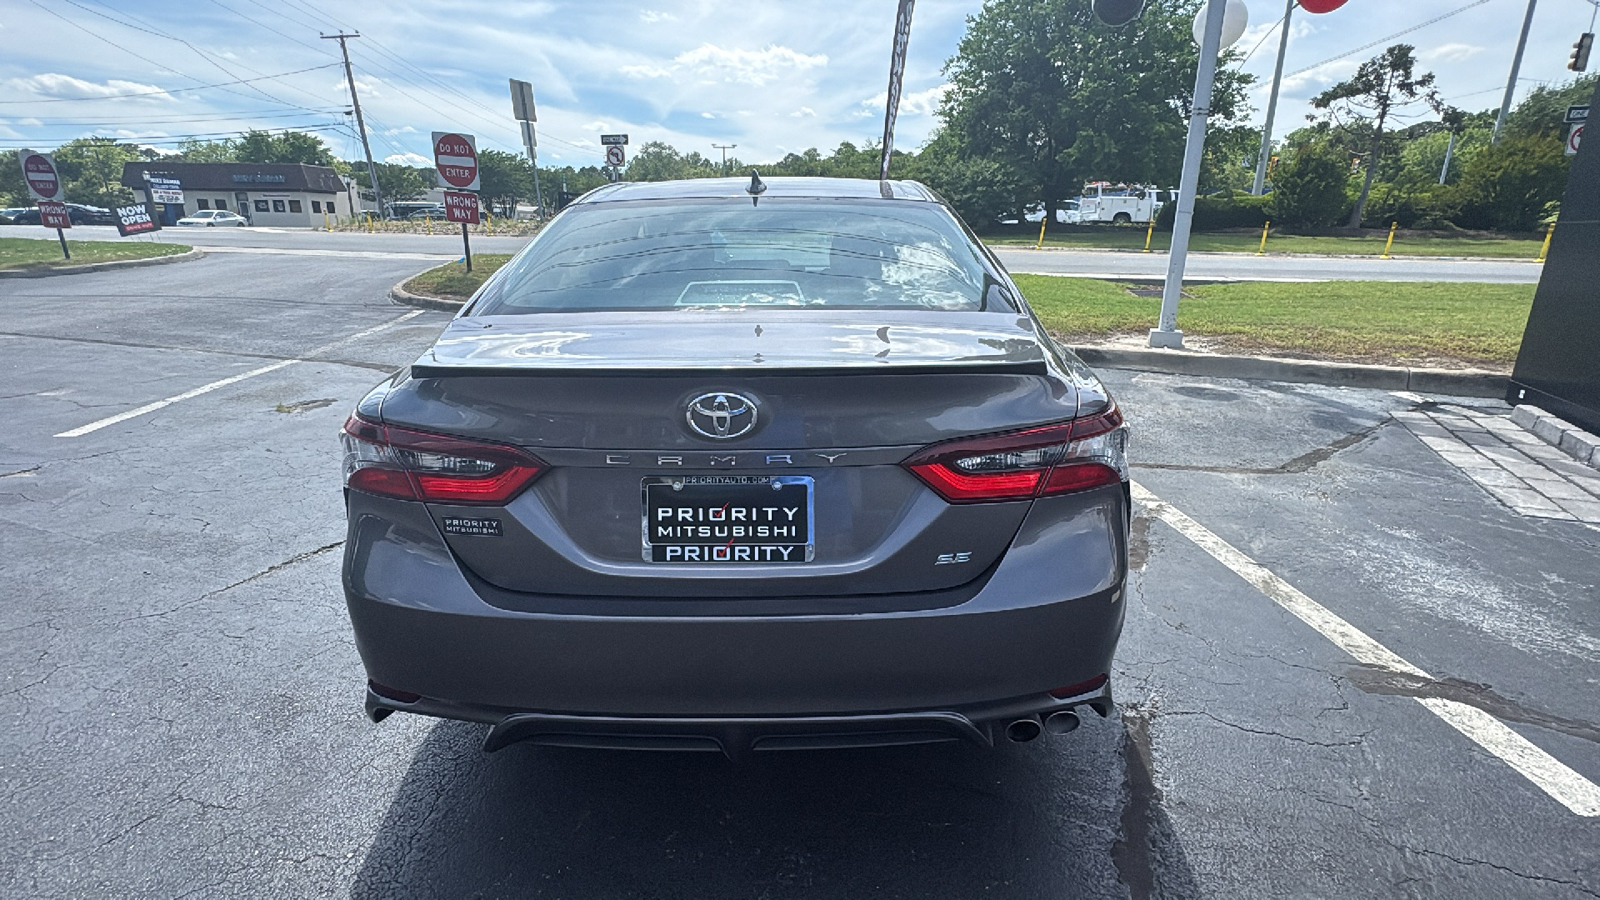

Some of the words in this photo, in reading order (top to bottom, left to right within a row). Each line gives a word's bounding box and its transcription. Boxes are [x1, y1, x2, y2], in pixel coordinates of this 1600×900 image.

[440, 143, 451, 153] DO
[453, 144, 470, 154] NOT
[445, 167, 471, 179] ENTER
[446, 195, 477, 209] WRONG
[39, 205, 66, 215] WRONG
[116, 204, 146, 218] NOW
[453, 208, 472, 220] WAY
[47, 215, 64, 224] WAY
[121, 213, 152, 226] OPEN
[606, 452, 848, 466] CAMRY
[685, 476, 770, 485] PRIORITYAUTO.COM
[657, 506, 799, 522] PRIORITY
[445, 519, 498, 527] PRIORITY
[446, 526, 499, 534] MITSUBISHI
[658, 525, 797, 537] MITSUBISHI
[666, 545, 794, 561] PRIORITY
[934, 551, 973, 566] SE
